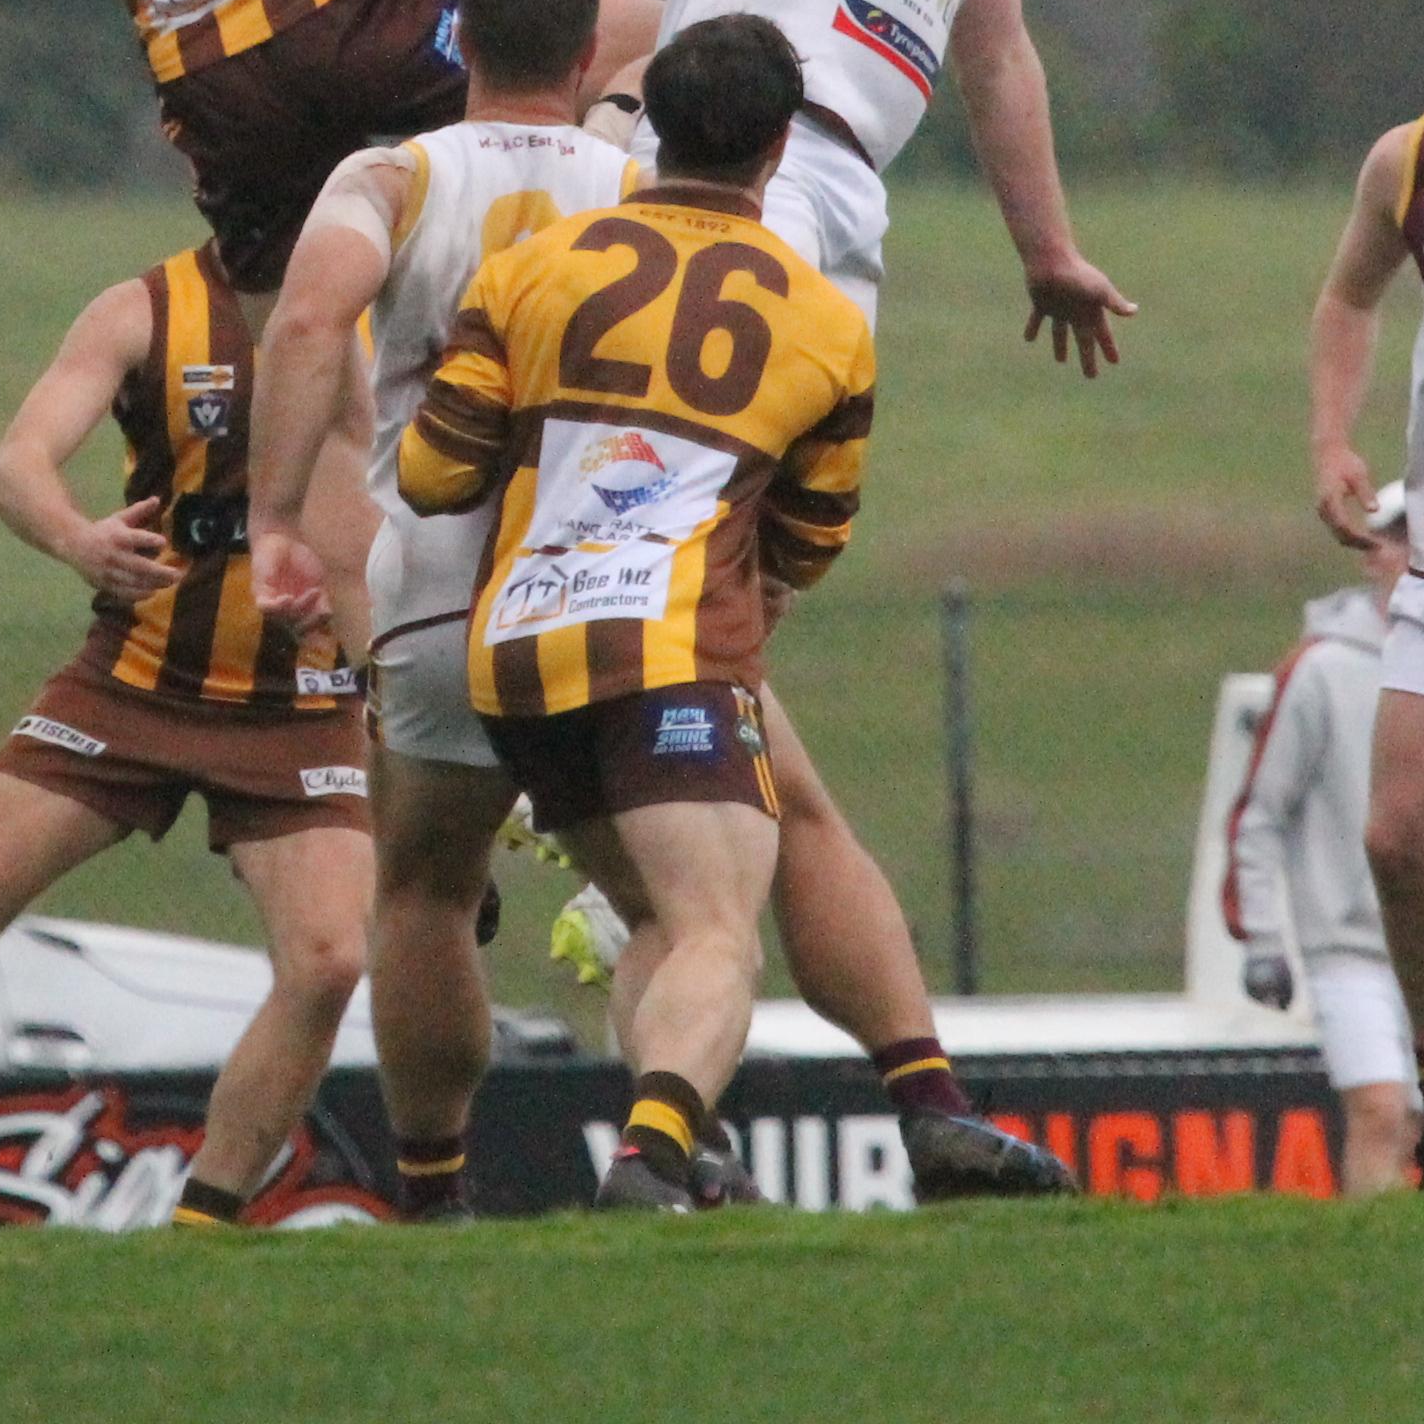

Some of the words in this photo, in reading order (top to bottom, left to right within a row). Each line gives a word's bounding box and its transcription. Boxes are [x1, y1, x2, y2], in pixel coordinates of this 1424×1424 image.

[559, 217, 789, 417] 26
[572, 568, 610, 594] Gee
[568, 593, 649, 615] Contractors
